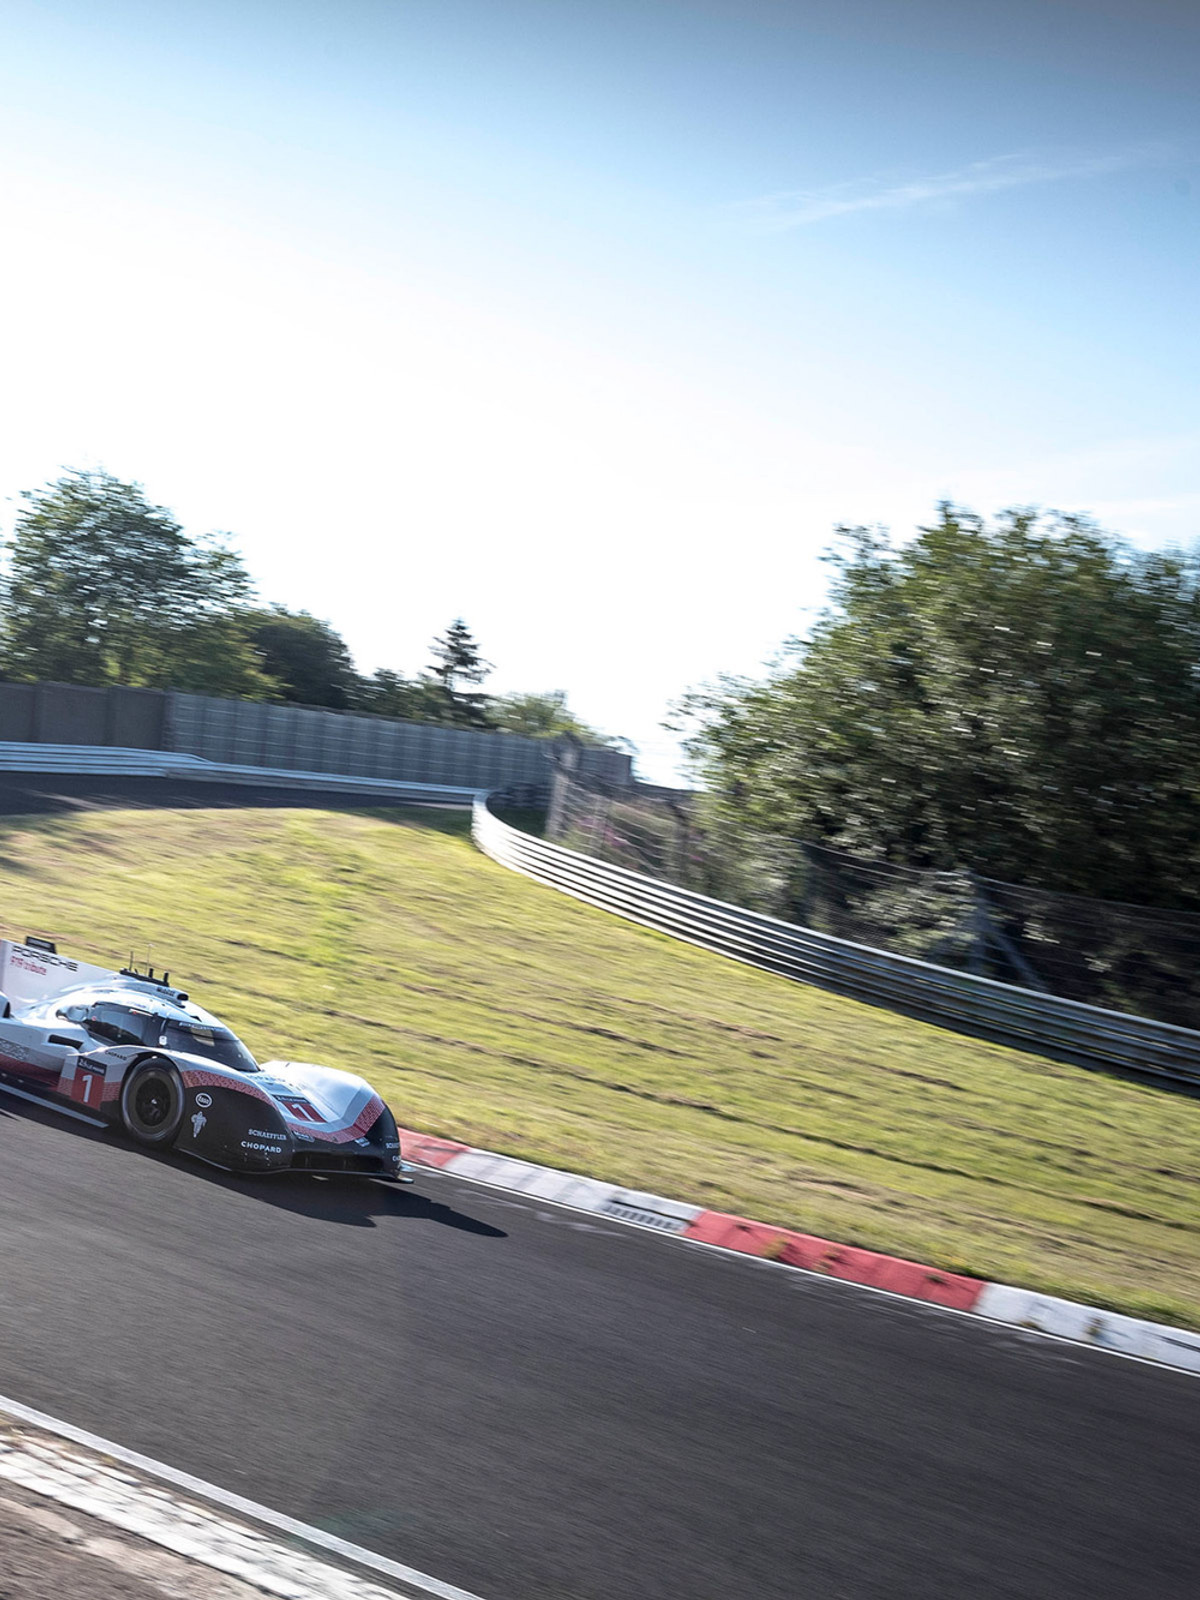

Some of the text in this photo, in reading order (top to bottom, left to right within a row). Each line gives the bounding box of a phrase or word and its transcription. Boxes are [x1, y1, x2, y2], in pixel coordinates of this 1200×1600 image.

[12, 945, 79, 972] PORSCHE
[82, 1074, 93, 1103] 1
[292, 1103, 315, 1122] 1
[248, 1129, 287, 1141] SCHAEFFLER
[241, 1141, 282, 1154] CHOPARD
